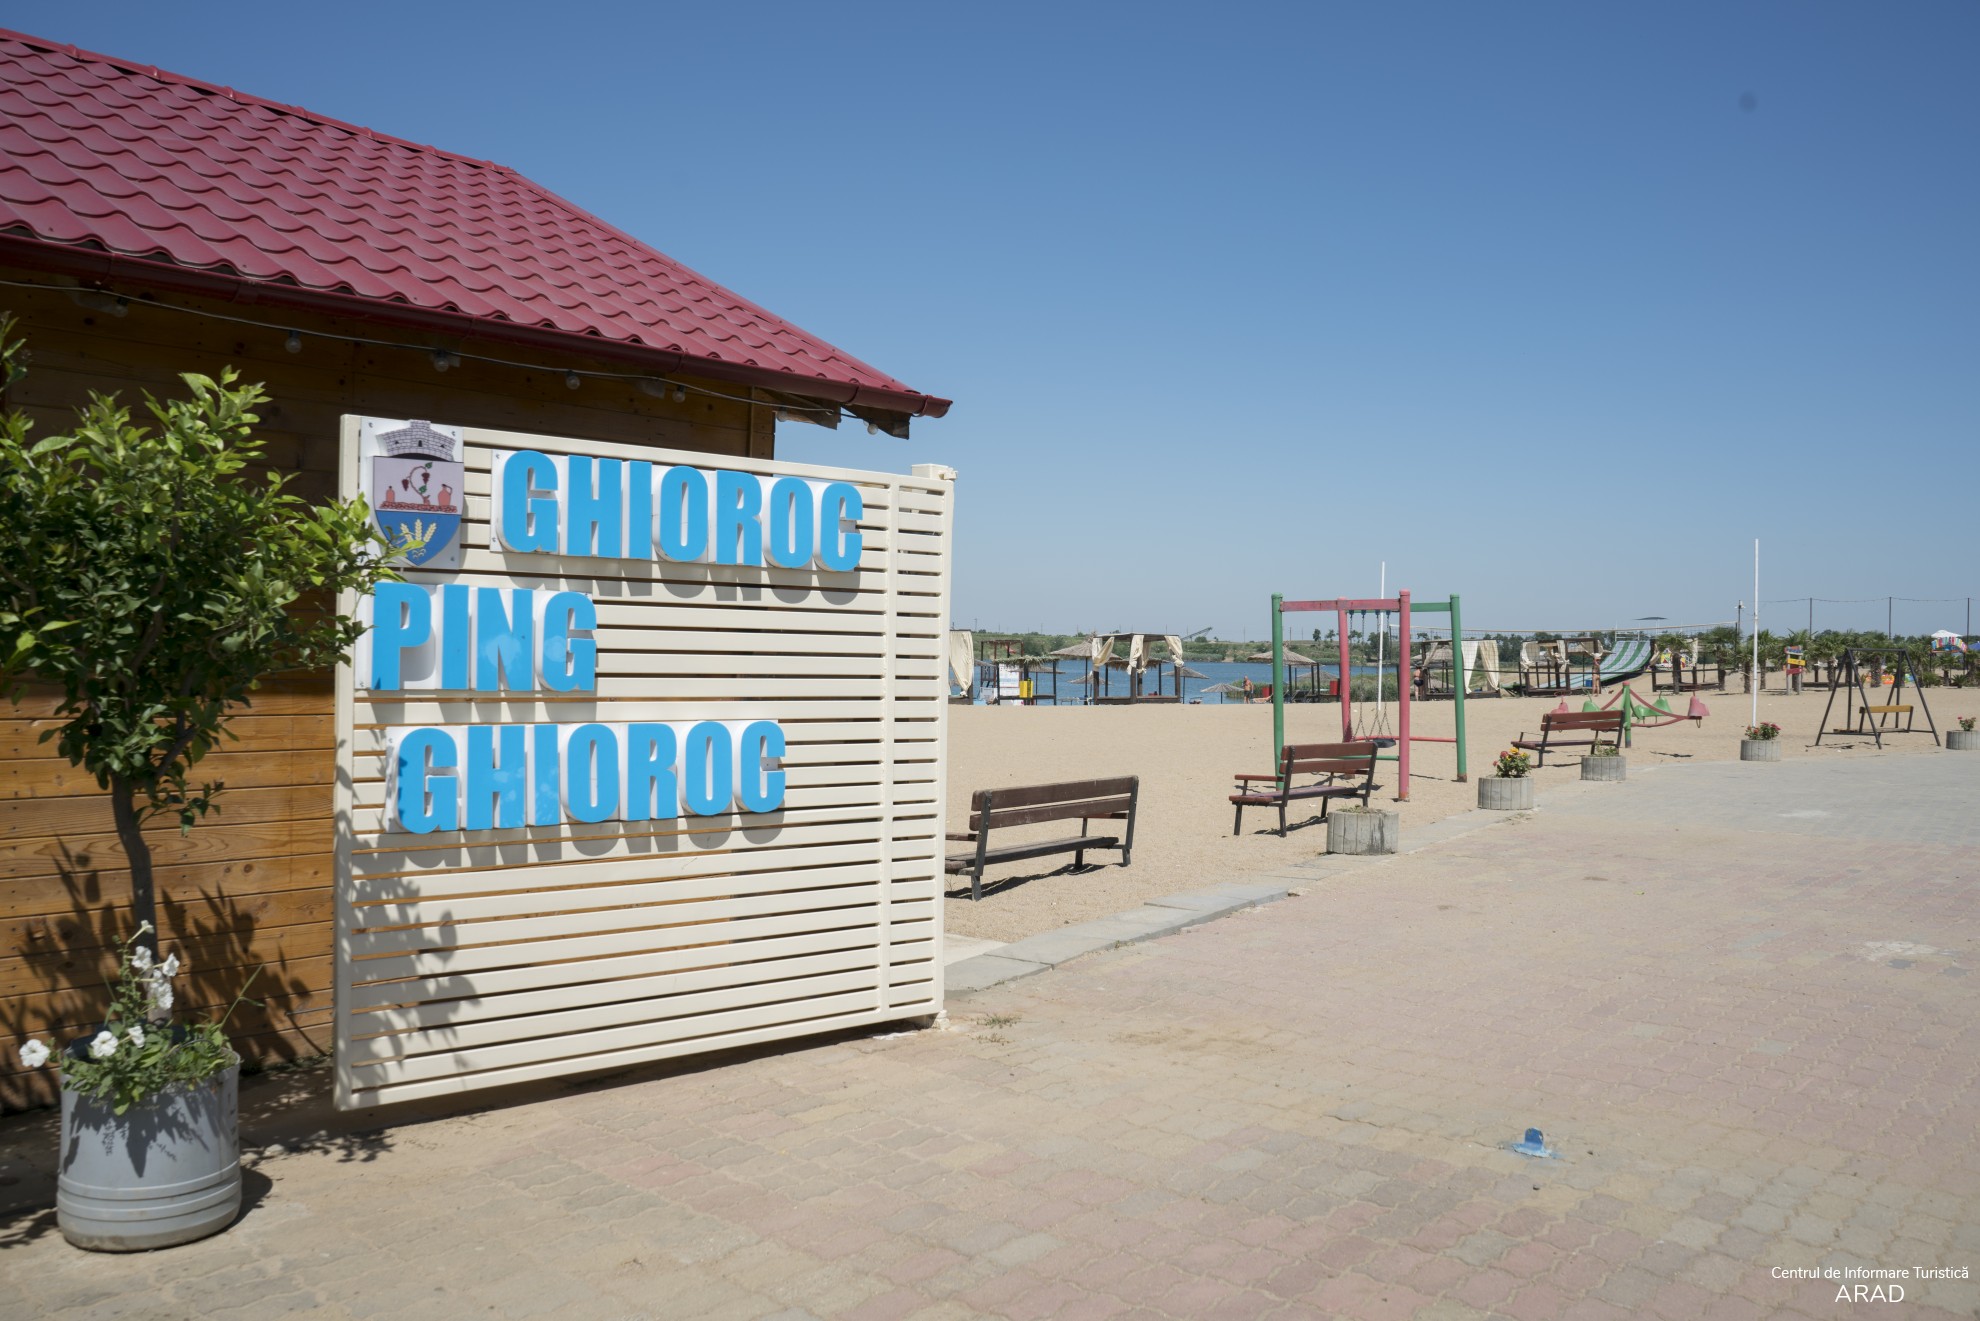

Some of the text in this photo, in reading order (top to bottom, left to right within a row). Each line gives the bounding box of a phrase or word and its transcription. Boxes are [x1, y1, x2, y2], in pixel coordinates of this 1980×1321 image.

[503, 450, 863, 571] GHIOROC
[372, 583, 597, 691] PING
[398, 721, 785, 834] GHIOROC
